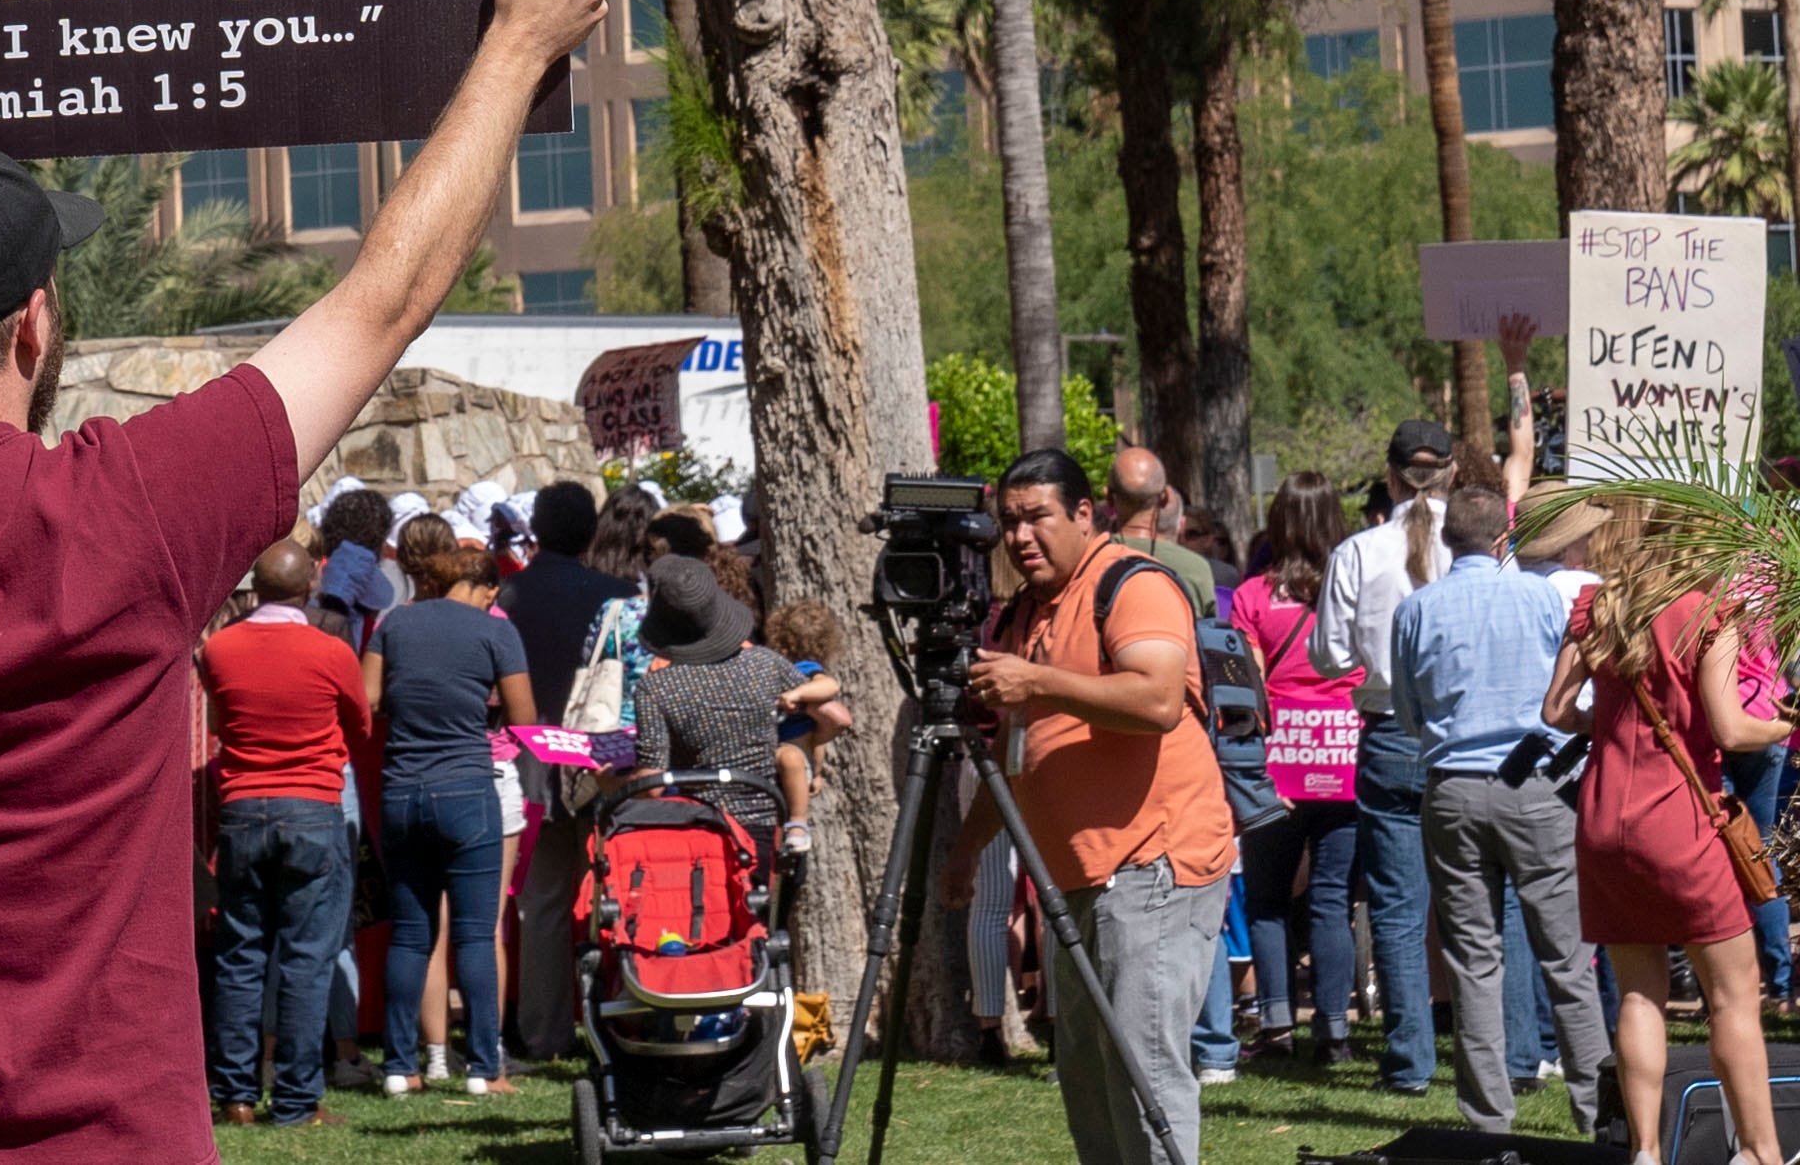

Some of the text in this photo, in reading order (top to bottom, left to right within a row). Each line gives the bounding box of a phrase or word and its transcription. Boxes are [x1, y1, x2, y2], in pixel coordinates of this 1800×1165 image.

[3, 24, 29, 60] I
[58, 18, 196, 57] knew
[153, 70, 247, 111] 1:5
[1578, 227, 1726, 262] #STOP THE
[1626, 266, 1715, 312] BANS
[1589, 325, 1725, 374] DEFEND
[584, 382, 664, 412] LAWS ARE
[1611, 378, 1757, 421] WOMEN'S
[601, 405, 662, 433] CLASS
[1584, 406, 1728, 449] RIGHTS
[1276, 708, 1360, 727] PROTEC
[1266, 746, 1358, 765] ABORTI
[1323, 728, 1360, 746] LEG
